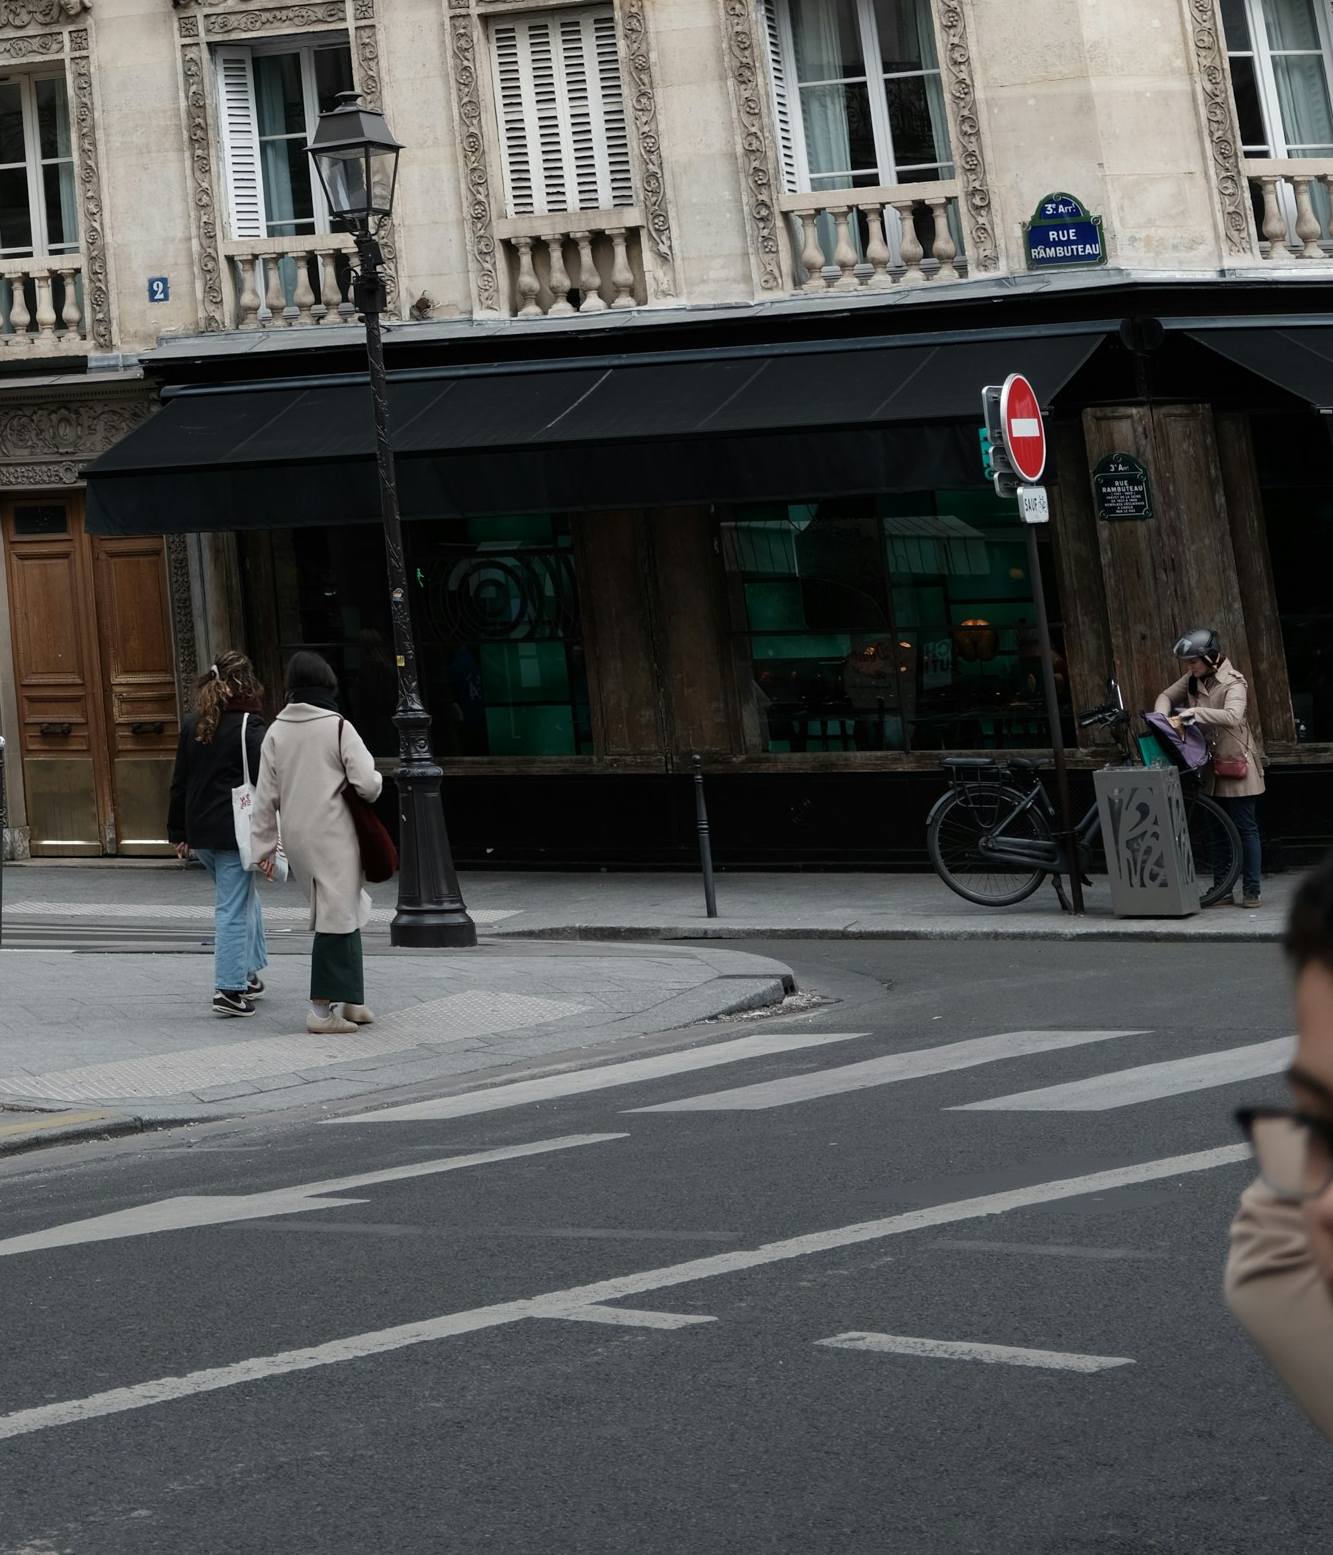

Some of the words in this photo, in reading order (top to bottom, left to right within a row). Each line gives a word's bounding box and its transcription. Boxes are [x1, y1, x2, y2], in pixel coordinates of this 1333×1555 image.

[1049, 229, 1077, 241] RUE
[1031, 244, 1100, 259] RAMBUTEAU
[153, 281, 164, 299] 2
[61, 421, 68, 437] 2
[1102, 485, 1143, 493] RAMBUTEAU
[1024, 497, 1038, 511] SAUF
